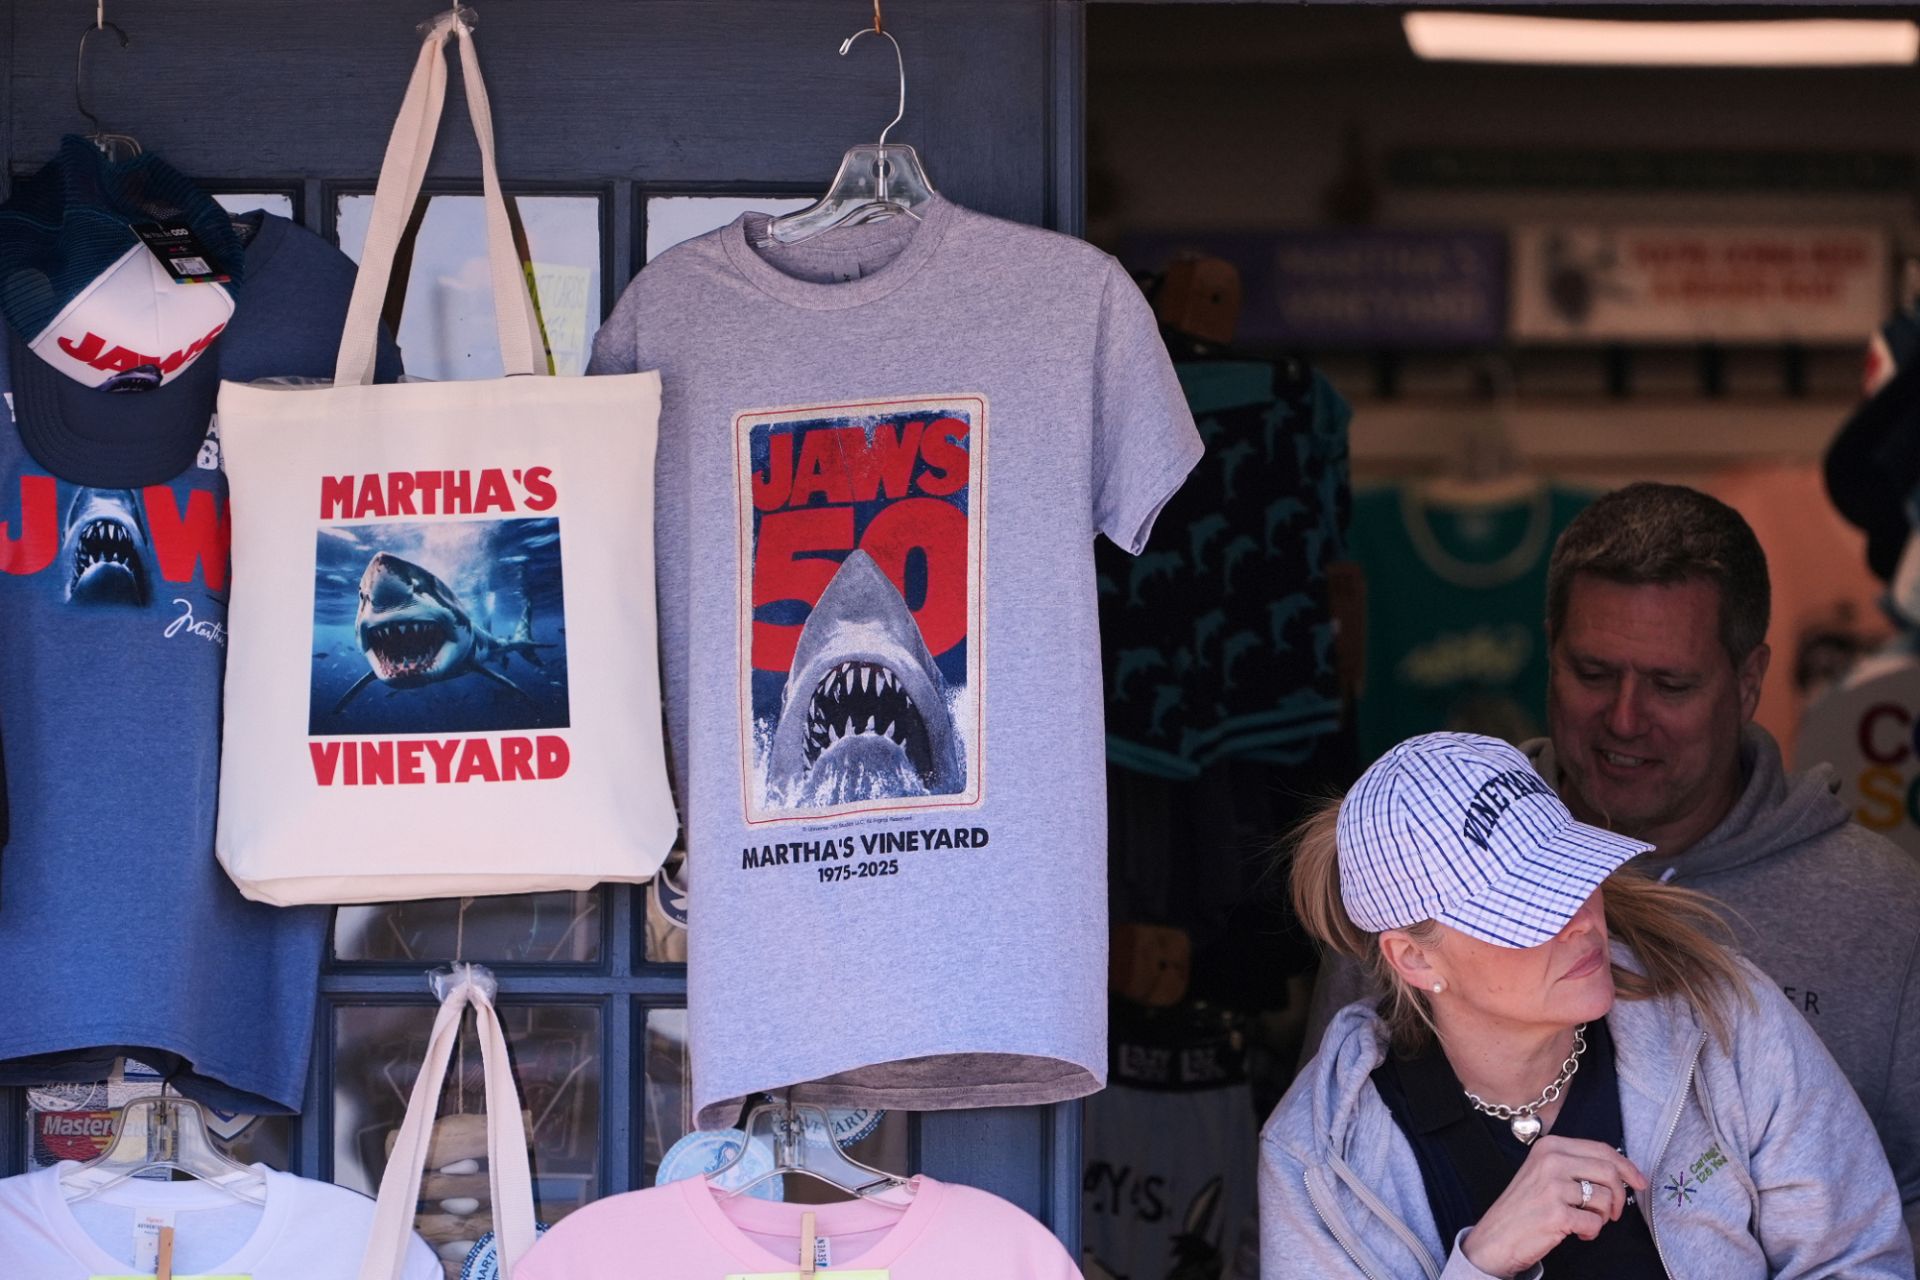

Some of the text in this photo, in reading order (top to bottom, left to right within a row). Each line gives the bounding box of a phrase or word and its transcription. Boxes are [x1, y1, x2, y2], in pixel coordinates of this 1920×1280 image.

[751, 417, 970, 511] JAWS
[319, 466, 557, 520] MARTHA'S
[751, 497, 968, 673] 50
[308, 735, 571, 786] VINEYARD
[742, 827, 990, 870] MARTHA'S VINEYARD
[817, 859, 899, 883] 1975-2025
